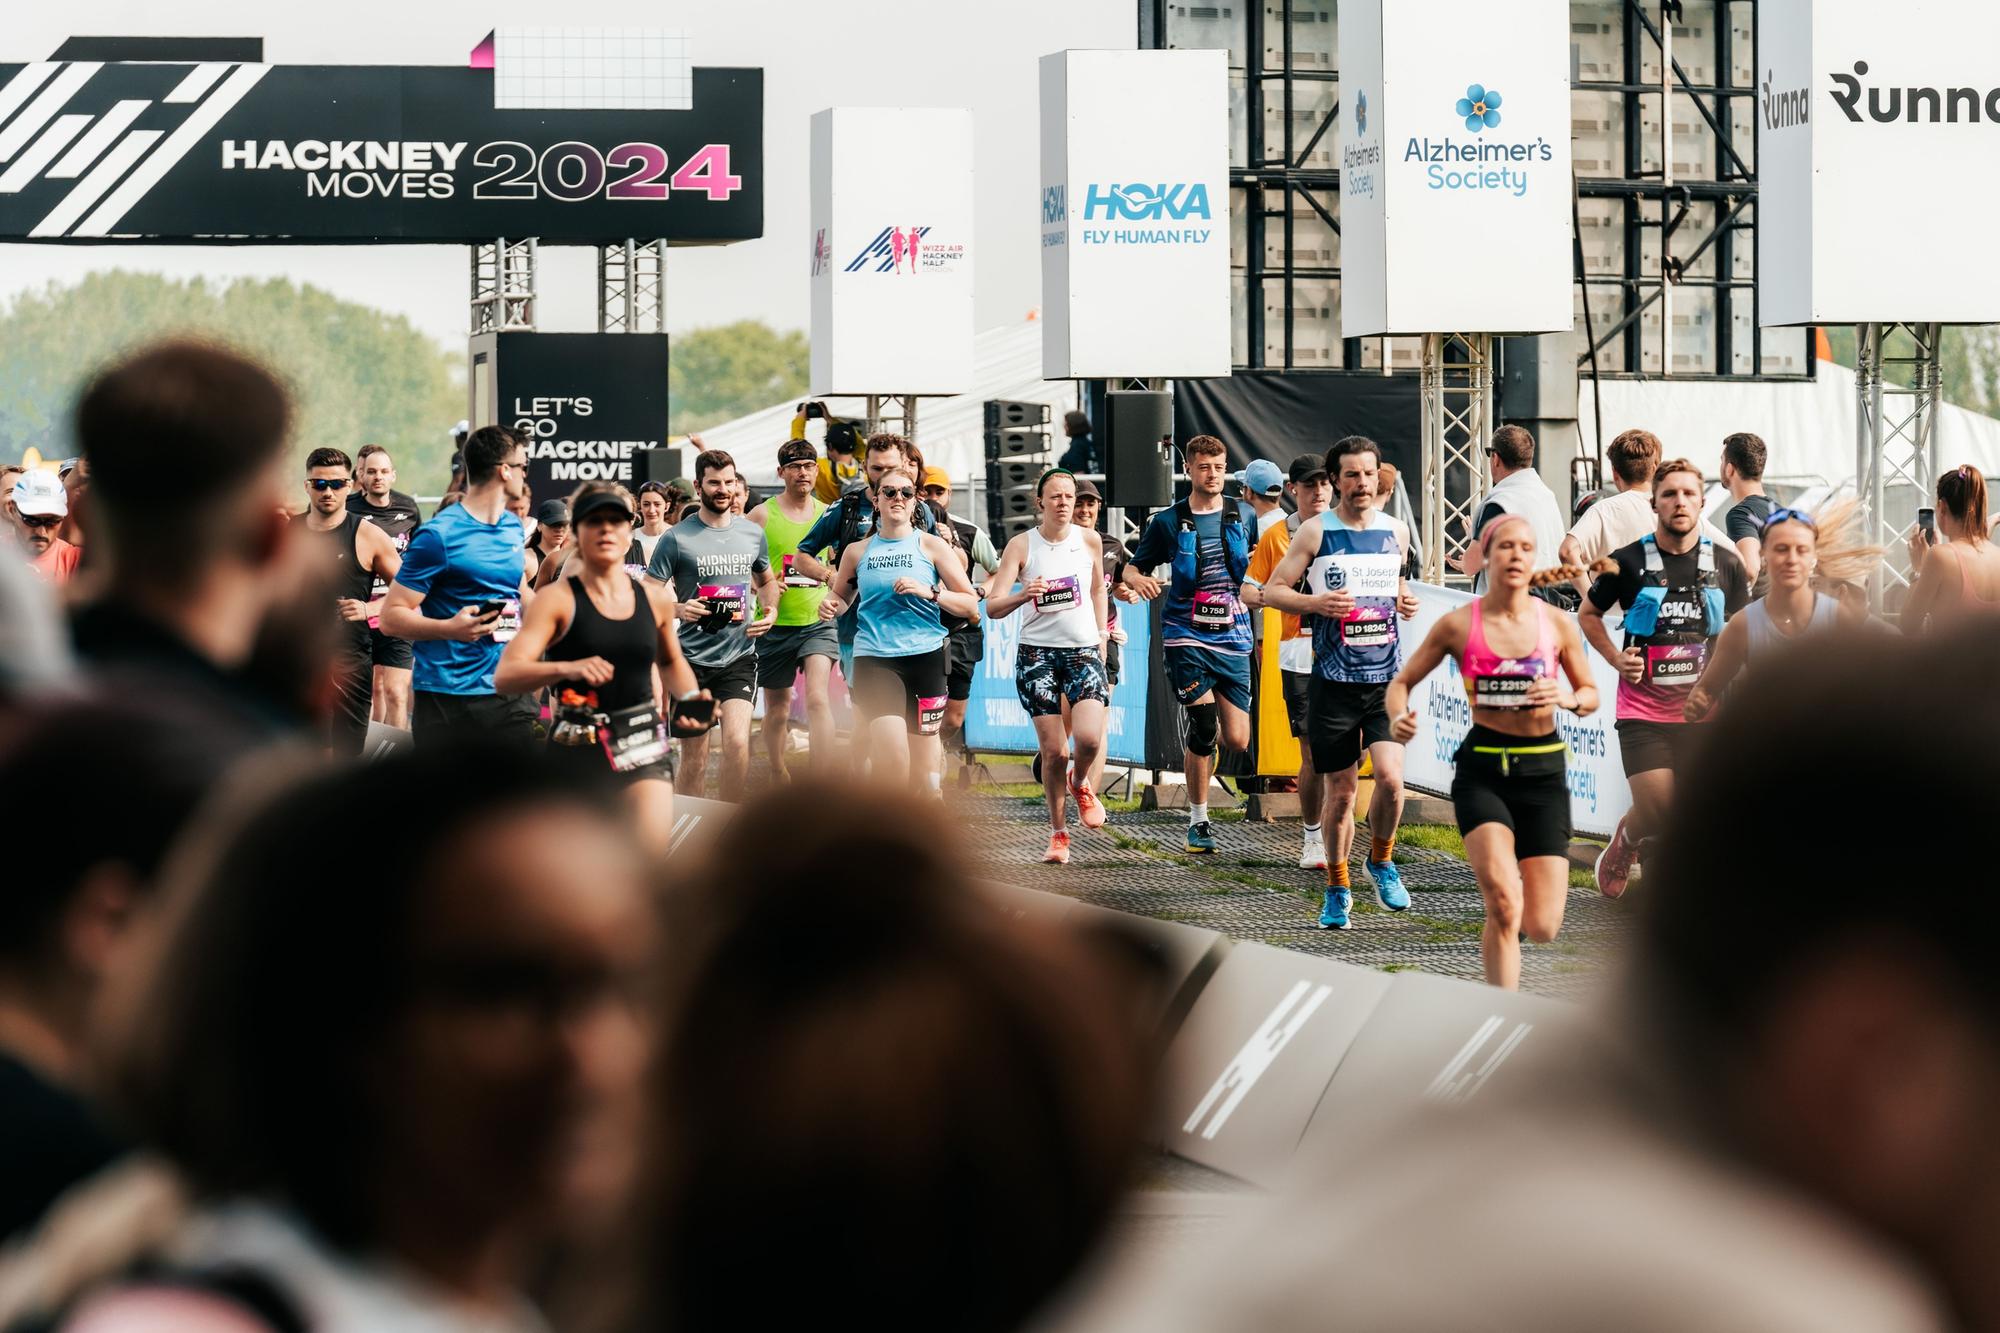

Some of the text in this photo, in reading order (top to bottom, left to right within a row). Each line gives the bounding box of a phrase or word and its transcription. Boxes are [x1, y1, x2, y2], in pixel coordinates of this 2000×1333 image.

[1762, 69, 1809, 130] Runna
[221, 139, 469, 171] HACKNEY
[1404, 136, 1552, 162] Alzheimer's
[473, 141, 742, 202] 2024
[1427, 164, 1527, 197] Society
[306, 171, 456, 199] MOVES
[1349, 169, 1374, 199] Society
[1083, 182, 1212, 221] HOKA
[1083, 229, 1211, 244] FLY HUMAN FLY
[922, 244, 964, 252] WIZZ AIR
[922, 252, 964, 260] HACKNEY
[514, 396, 593, 416] LET'S
[514, 418, 558, 437] GO
[696, 553, 752, 567] MIDNIGHT
[867, 559, 913, 570] RUNNERS
[868, 553, 913, 563] MIDNIGHT
[698, 564, 751, 577] RUNNERS
[1210, 607, 1225, 615] 758
[1363, 623, 1387, 633] 18242
[1668, 662, 1693, 673] 6680
[1566, 760, 1597, 813] ociety
